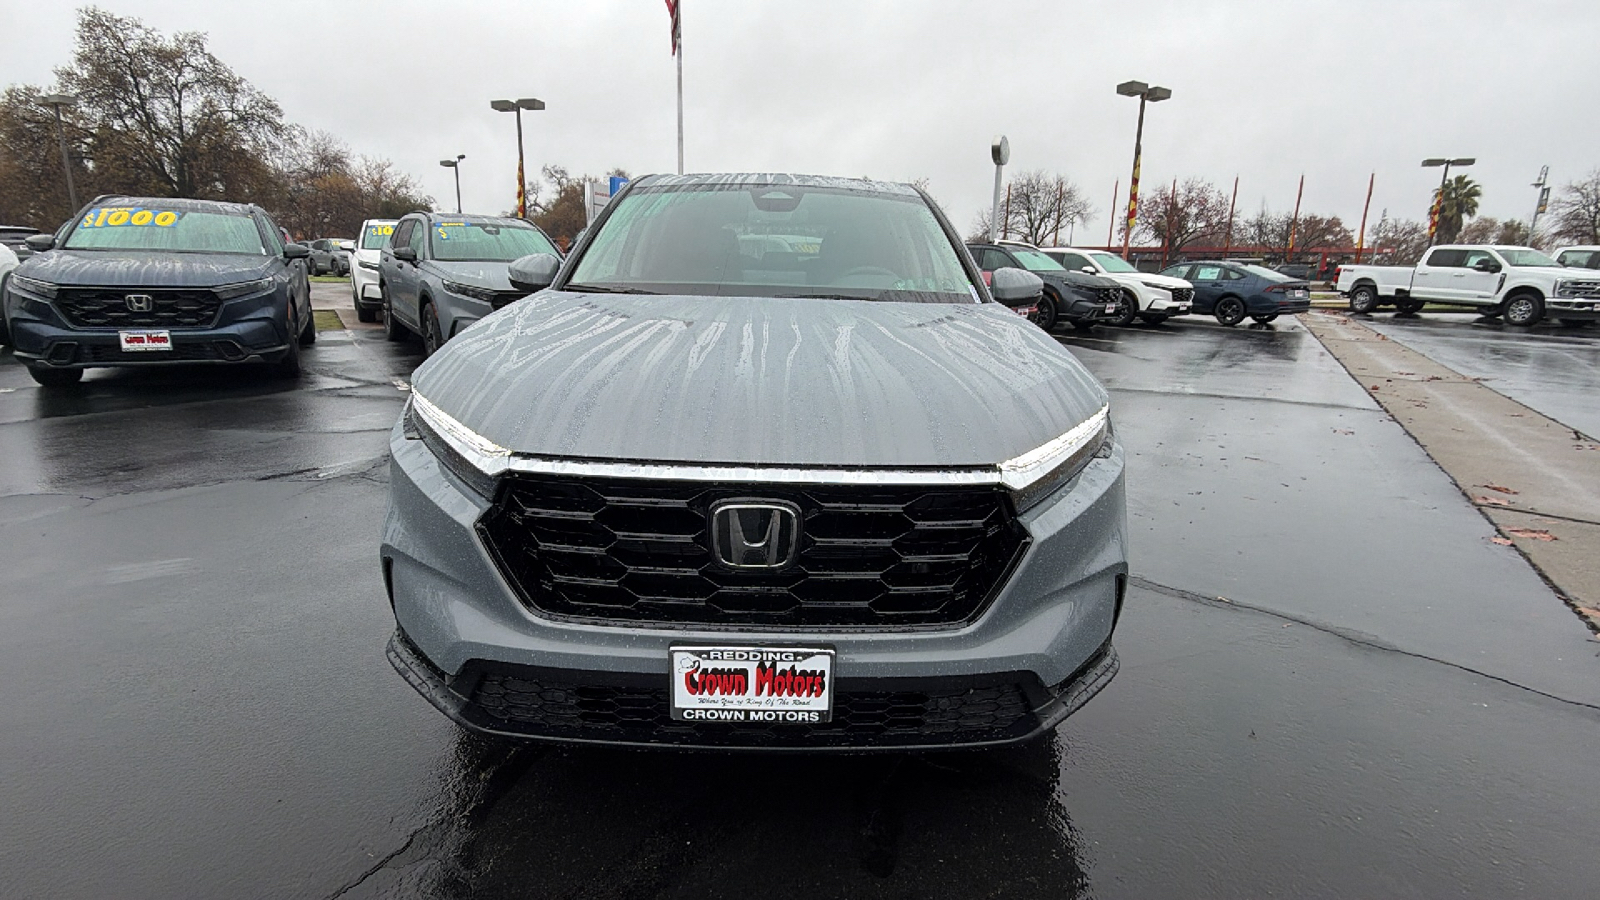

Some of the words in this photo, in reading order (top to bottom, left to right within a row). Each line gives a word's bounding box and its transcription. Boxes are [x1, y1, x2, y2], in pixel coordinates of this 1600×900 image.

[83, 209, 176, 227] $1000
[709, 651, 794, 661] REDDING
[684, 660, 749, 696] Crown
[755, 660, 826, 698] Motors
[746, 698, 763, 707] King
[765, 698, 775, 707] Of
[682, 709, 745, 721] CROWN
[751, 711, 820, 722] MOTORS
